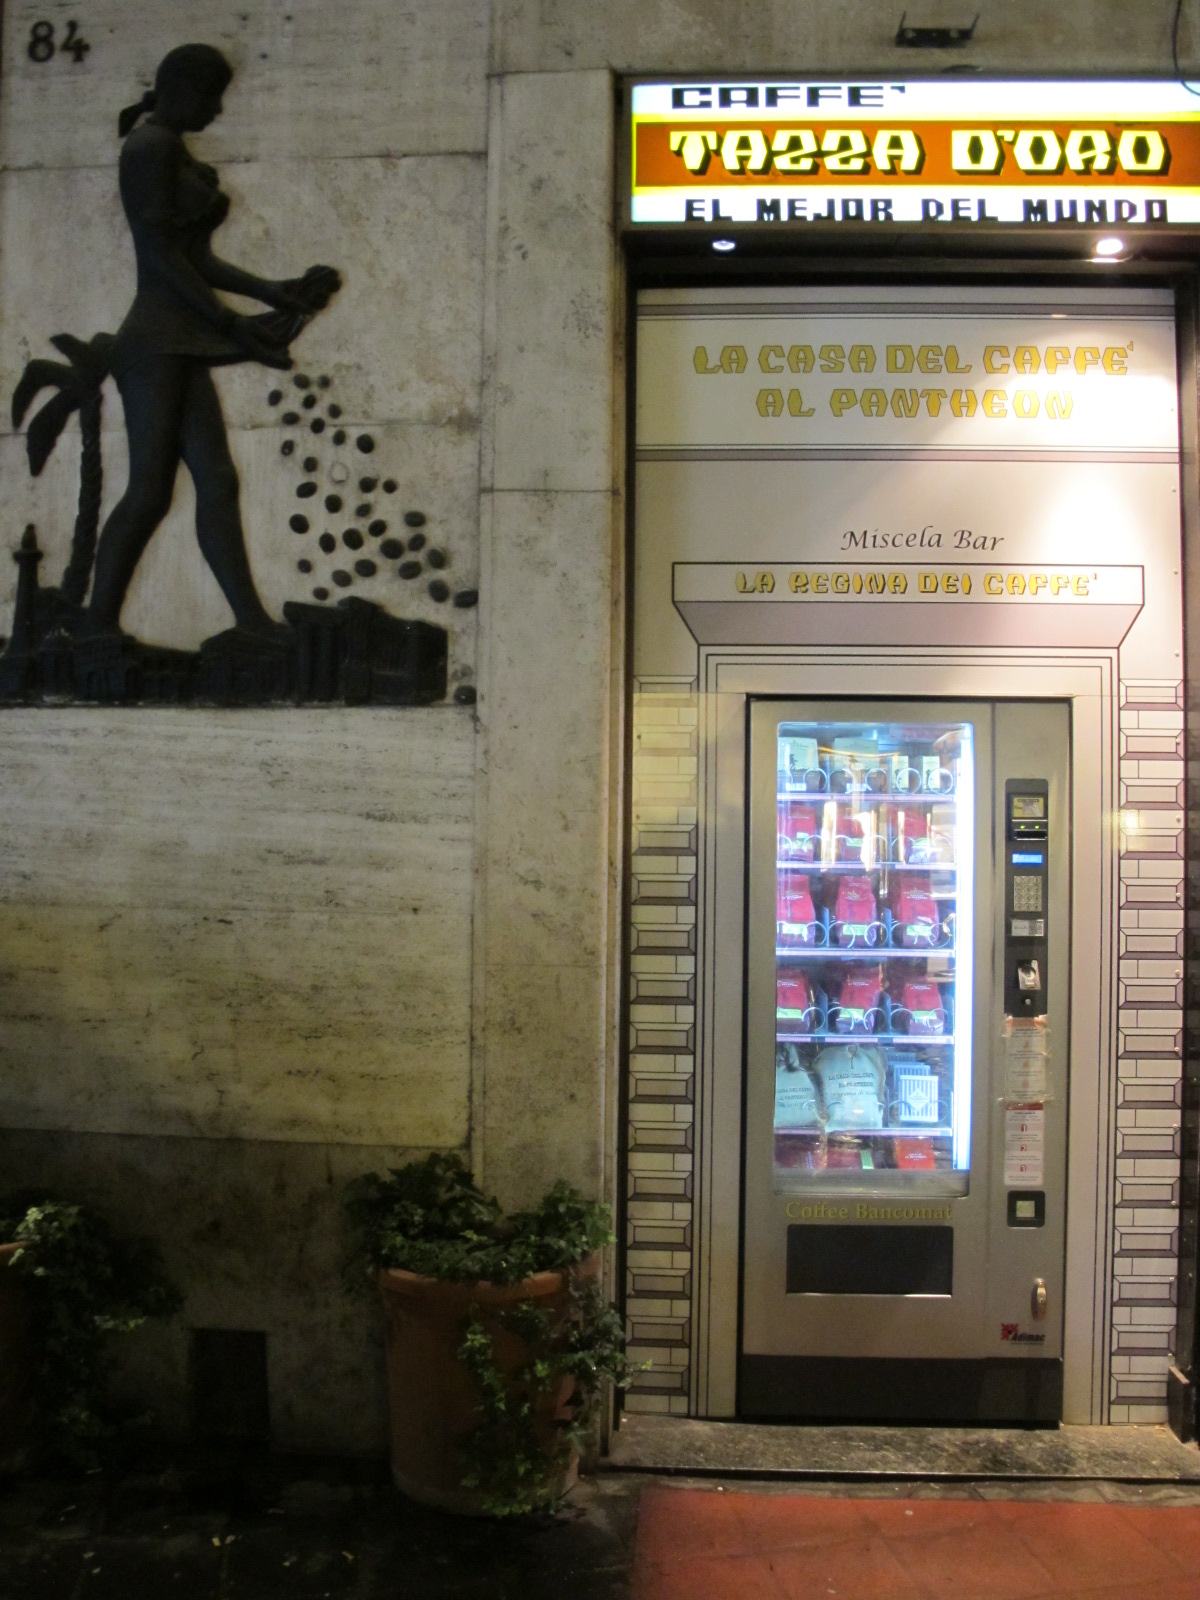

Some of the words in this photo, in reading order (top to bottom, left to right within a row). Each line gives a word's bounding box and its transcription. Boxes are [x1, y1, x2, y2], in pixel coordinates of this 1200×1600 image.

[27, 20, 91, 63] 84
[669, 129, 926, 175] TAZZA
[950, 130, 1172, 176] D'ORO
[685, 198, 733, 222] EL
[756, 198, 893, 222] MEJOR
[922, 198, 999, 222] DEL
[1023, 198, 1168, 223] MUNDO
[693, 345, 748, 374] LA
[757, 345, 877, 374] CASA
[886, 345, 972, 374] DEL
[755, 388, 816, 417] AL
[829, 388, 1074, 419] PANTHEON
[840, 525, 943, 551] Miscela
[953, 529, 1005, 552] Bar
[735, 572, 776, 594] LA
[788, 572, 908, 595] REGINA
[918, 573, 972, 595] DEI
[785, 1201, 849, 1220] Coffee
[855, 1203, 953, 1220] Bancomat
